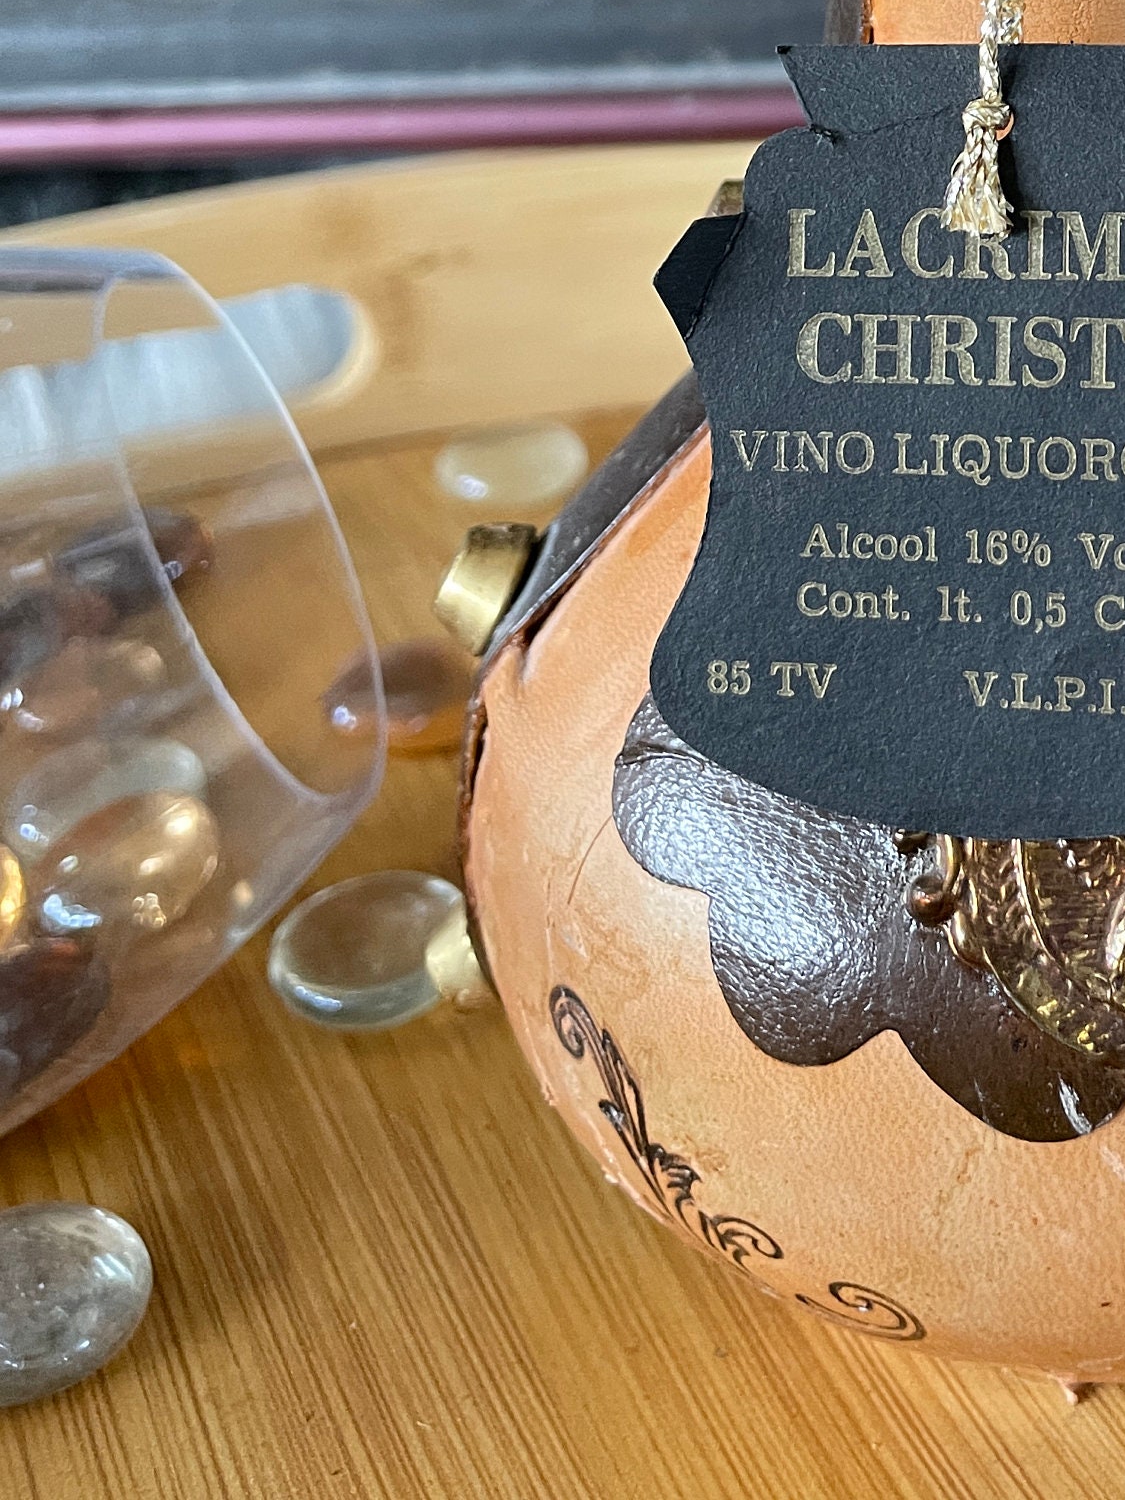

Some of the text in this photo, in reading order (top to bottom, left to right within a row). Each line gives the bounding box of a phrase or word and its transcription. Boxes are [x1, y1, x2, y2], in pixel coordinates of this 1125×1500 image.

[730, 430, 874, 473] VINO
[800, 523, 938, 562] Alcool
[965, 529, 1051, 566] 16%
[797, 582, 910, 621] Cont.
[1010, 591, 1067, 633] 0,5
[706, 659, 837, 699] 85 TV
